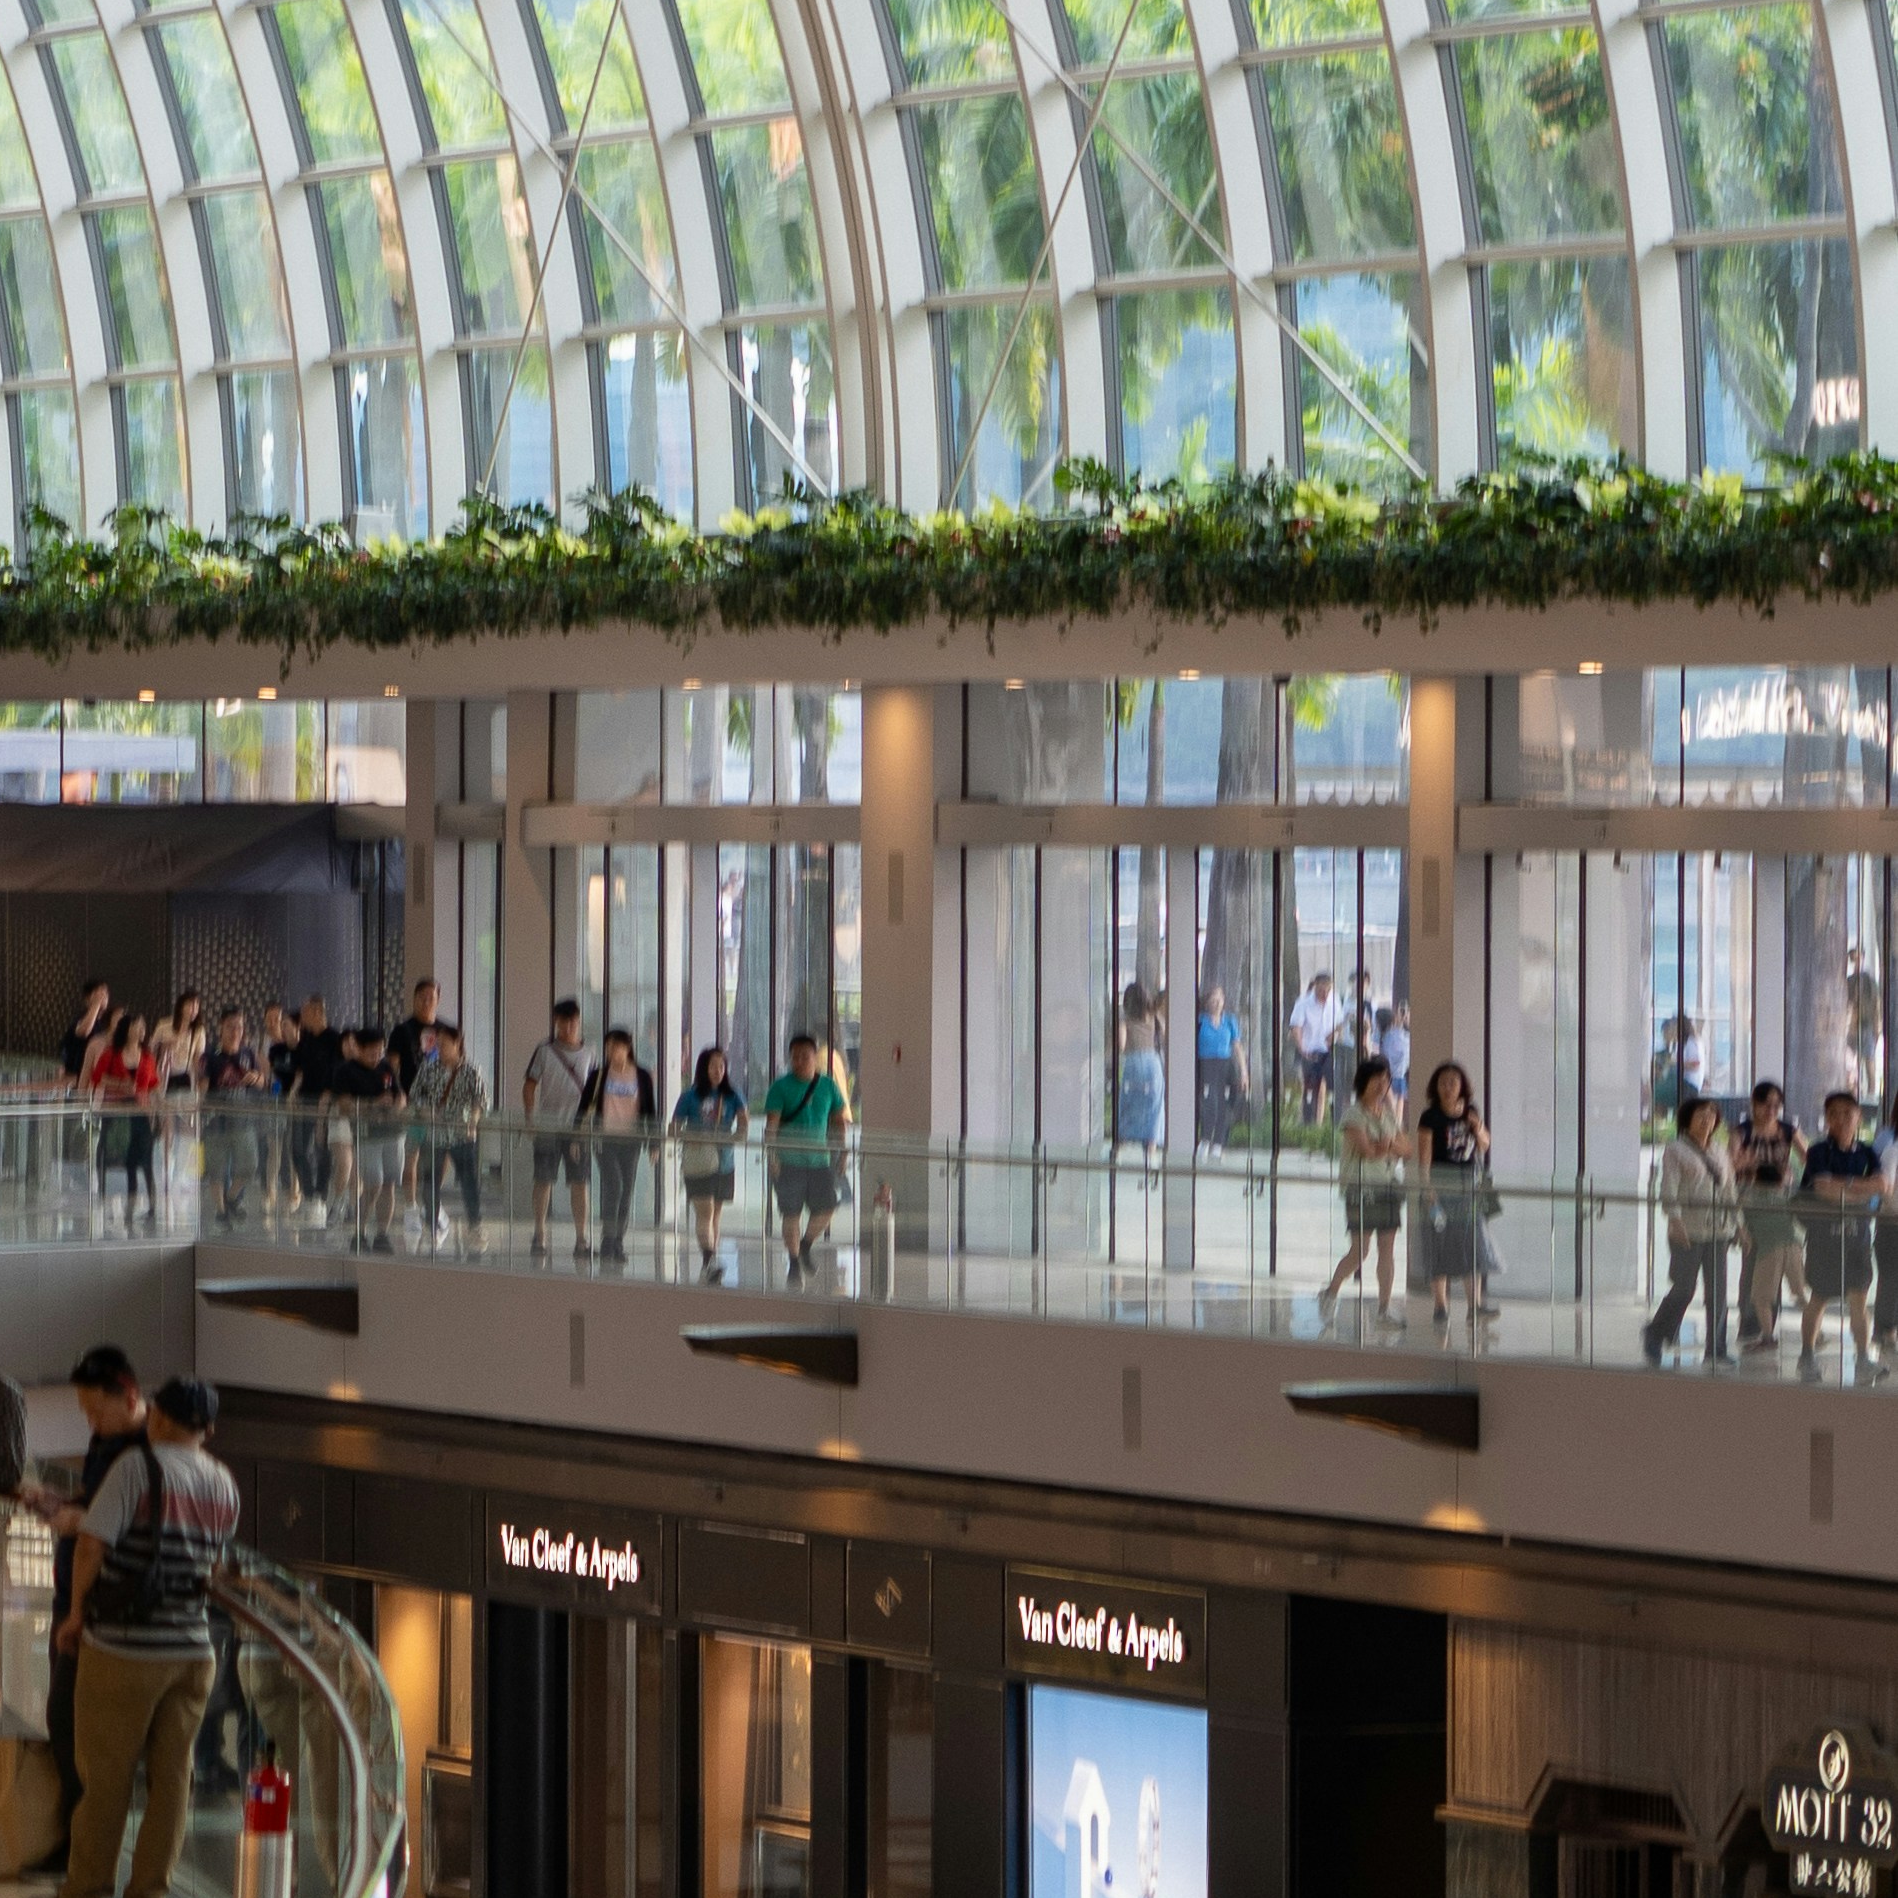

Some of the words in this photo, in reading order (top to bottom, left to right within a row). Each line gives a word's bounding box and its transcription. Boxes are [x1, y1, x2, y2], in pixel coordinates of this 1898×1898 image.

[500, 1523, 530, 1568] Van
[532, 1527, 574, 1574] Cleef
[575, 1541, 588, 1577] &
[589, 1536, 639, 1592] Arpels
[1018, 1595, 1054, 1645] Van
[1056, 1601, 1107, 1652] Cleef
[1107, 1616, 1123, 1655] &
[1124, 1612, 1184, 1672] Arpels
[1775, 1783, 1852, 1844] MOTT
[1860, 1796, 1893, 1851] 32
